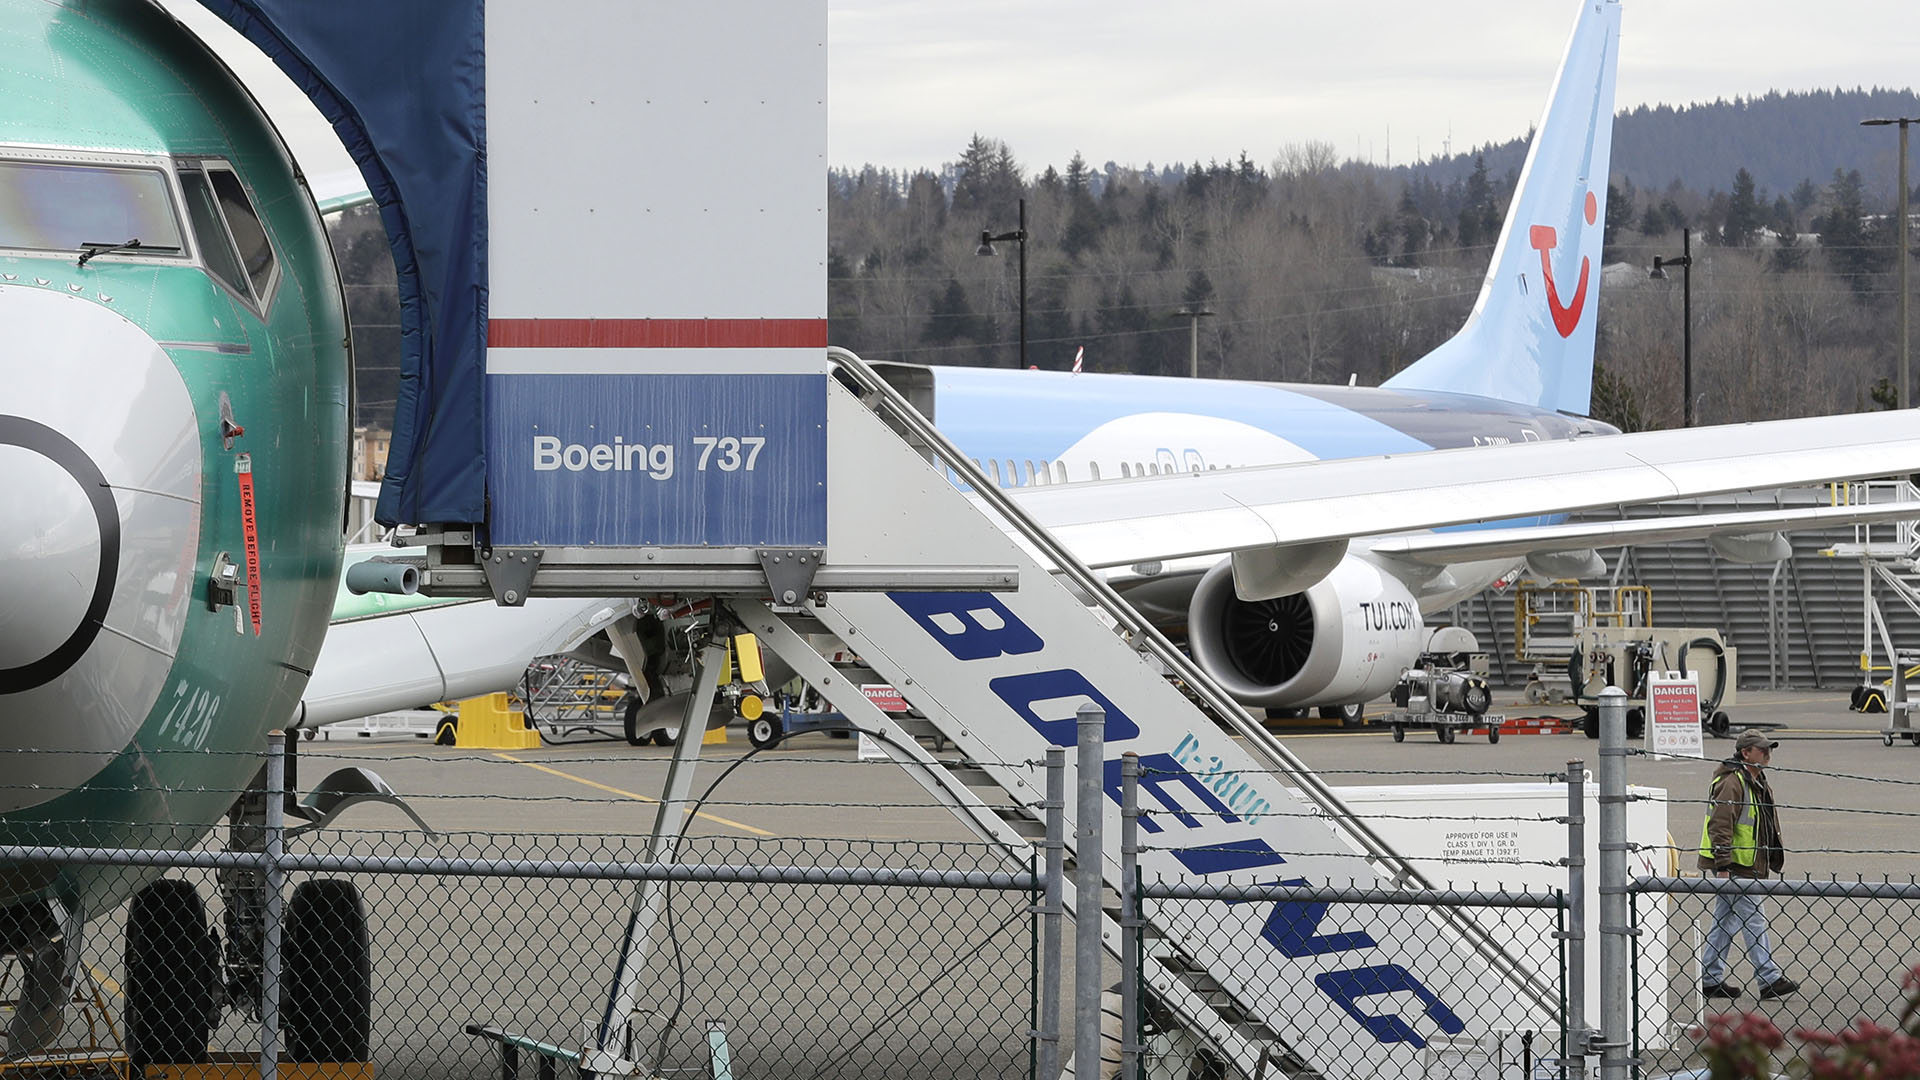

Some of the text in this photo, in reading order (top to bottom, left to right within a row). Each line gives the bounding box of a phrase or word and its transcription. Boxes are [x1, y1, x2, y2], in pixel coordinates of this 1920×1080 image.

[533, 435, 766, 481] Boeing 737
[242, 484, 261, 626] REMOVE BEFORE FLIGHT
[1359, 602, 1416, 631] TUI.COM
[864, 690, 902, 698] DANGE
[1654, 687, 1696, 695] DANGER
[159, 679, 220, 751] 7426
[885, 592, 1464, 1048] BOEING
[1445, 832, 1478, 840] APPROVED
[1442, 849, 1460, 857] TEMP
[1461, 848, 1483, 856] RANGE
